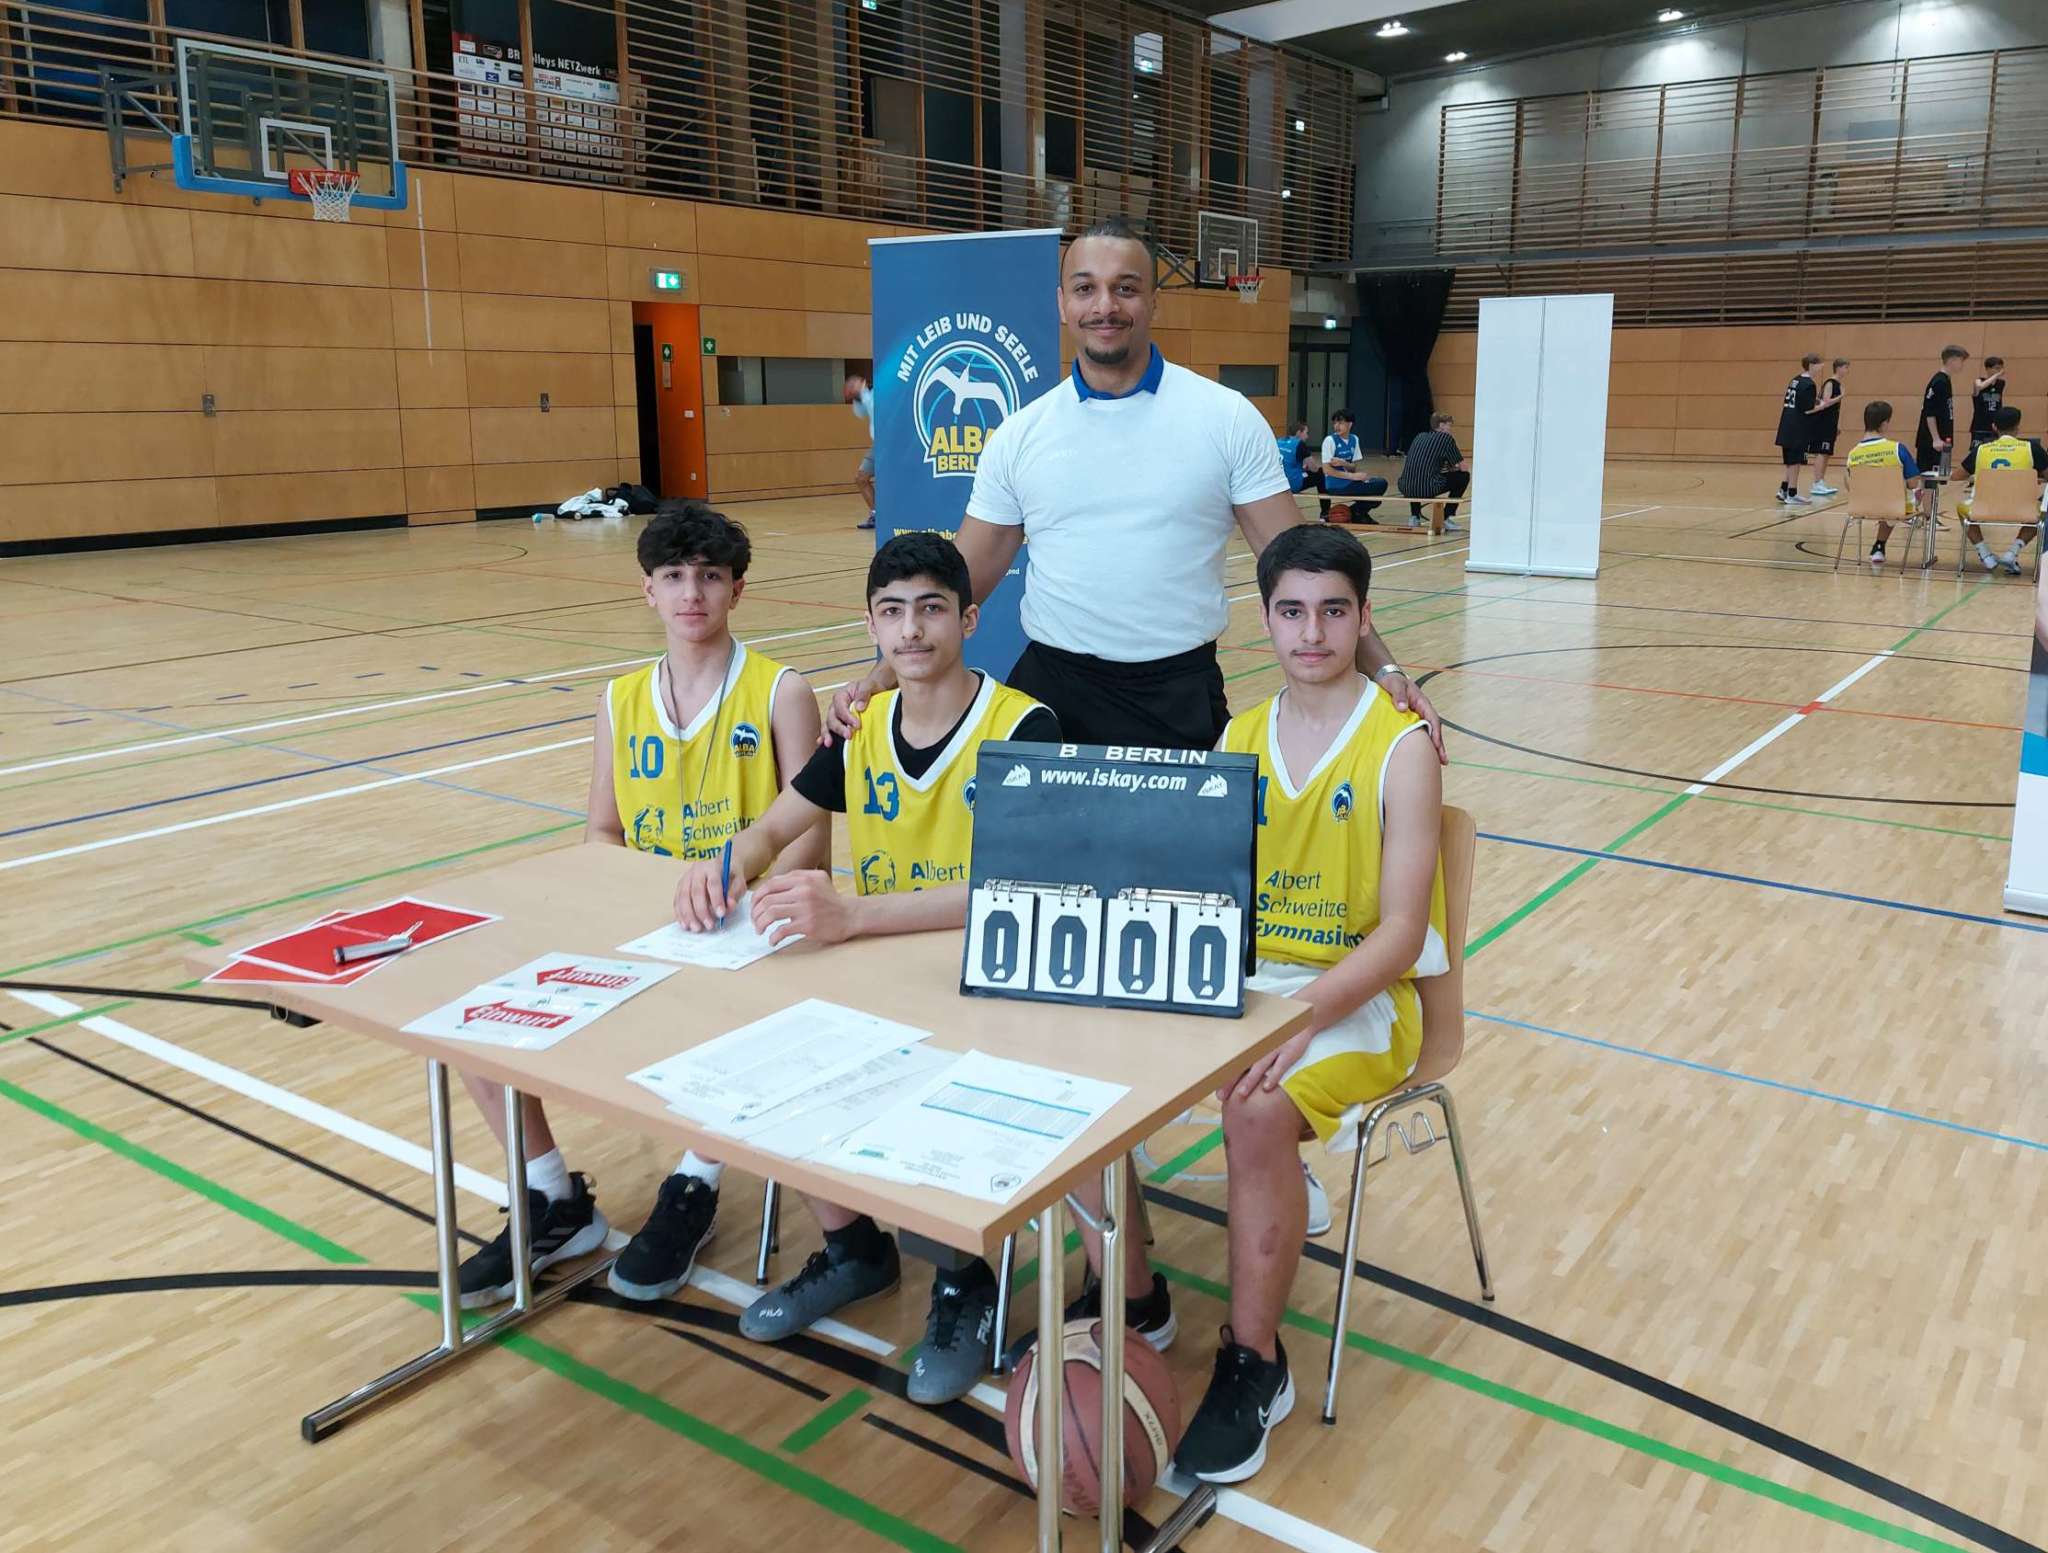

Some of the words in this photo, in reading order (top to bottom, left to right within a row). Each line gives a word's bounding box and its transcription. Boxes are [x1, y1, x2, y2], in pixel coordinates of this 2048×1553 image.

[532, 52, 556, 69] lleys
[557, 57, 601, 76] NETZwerk
[896, 344, 919, 383] MIT
[915, 316, 952, 349] LEIB
[956, 312, 992, 334] UND
[994, 325, 1039, 383] SEELE
[937, 454, 977, 472] BERL
[628, 735, 664, 779] 10
[1059, 743, 1078, 758] B
[1105, 745, 1208, 765] BERLIN
[1041, 767, 1187, 793] www.iskay.com
[864, 765, 900, 822] 13
[682, 796, 731, 819] Albert
[910, 861, 966, 881] Albert
[1265, 868, 1321, 890] Albert
[1256, 892, 1348, 918] Schweitze
